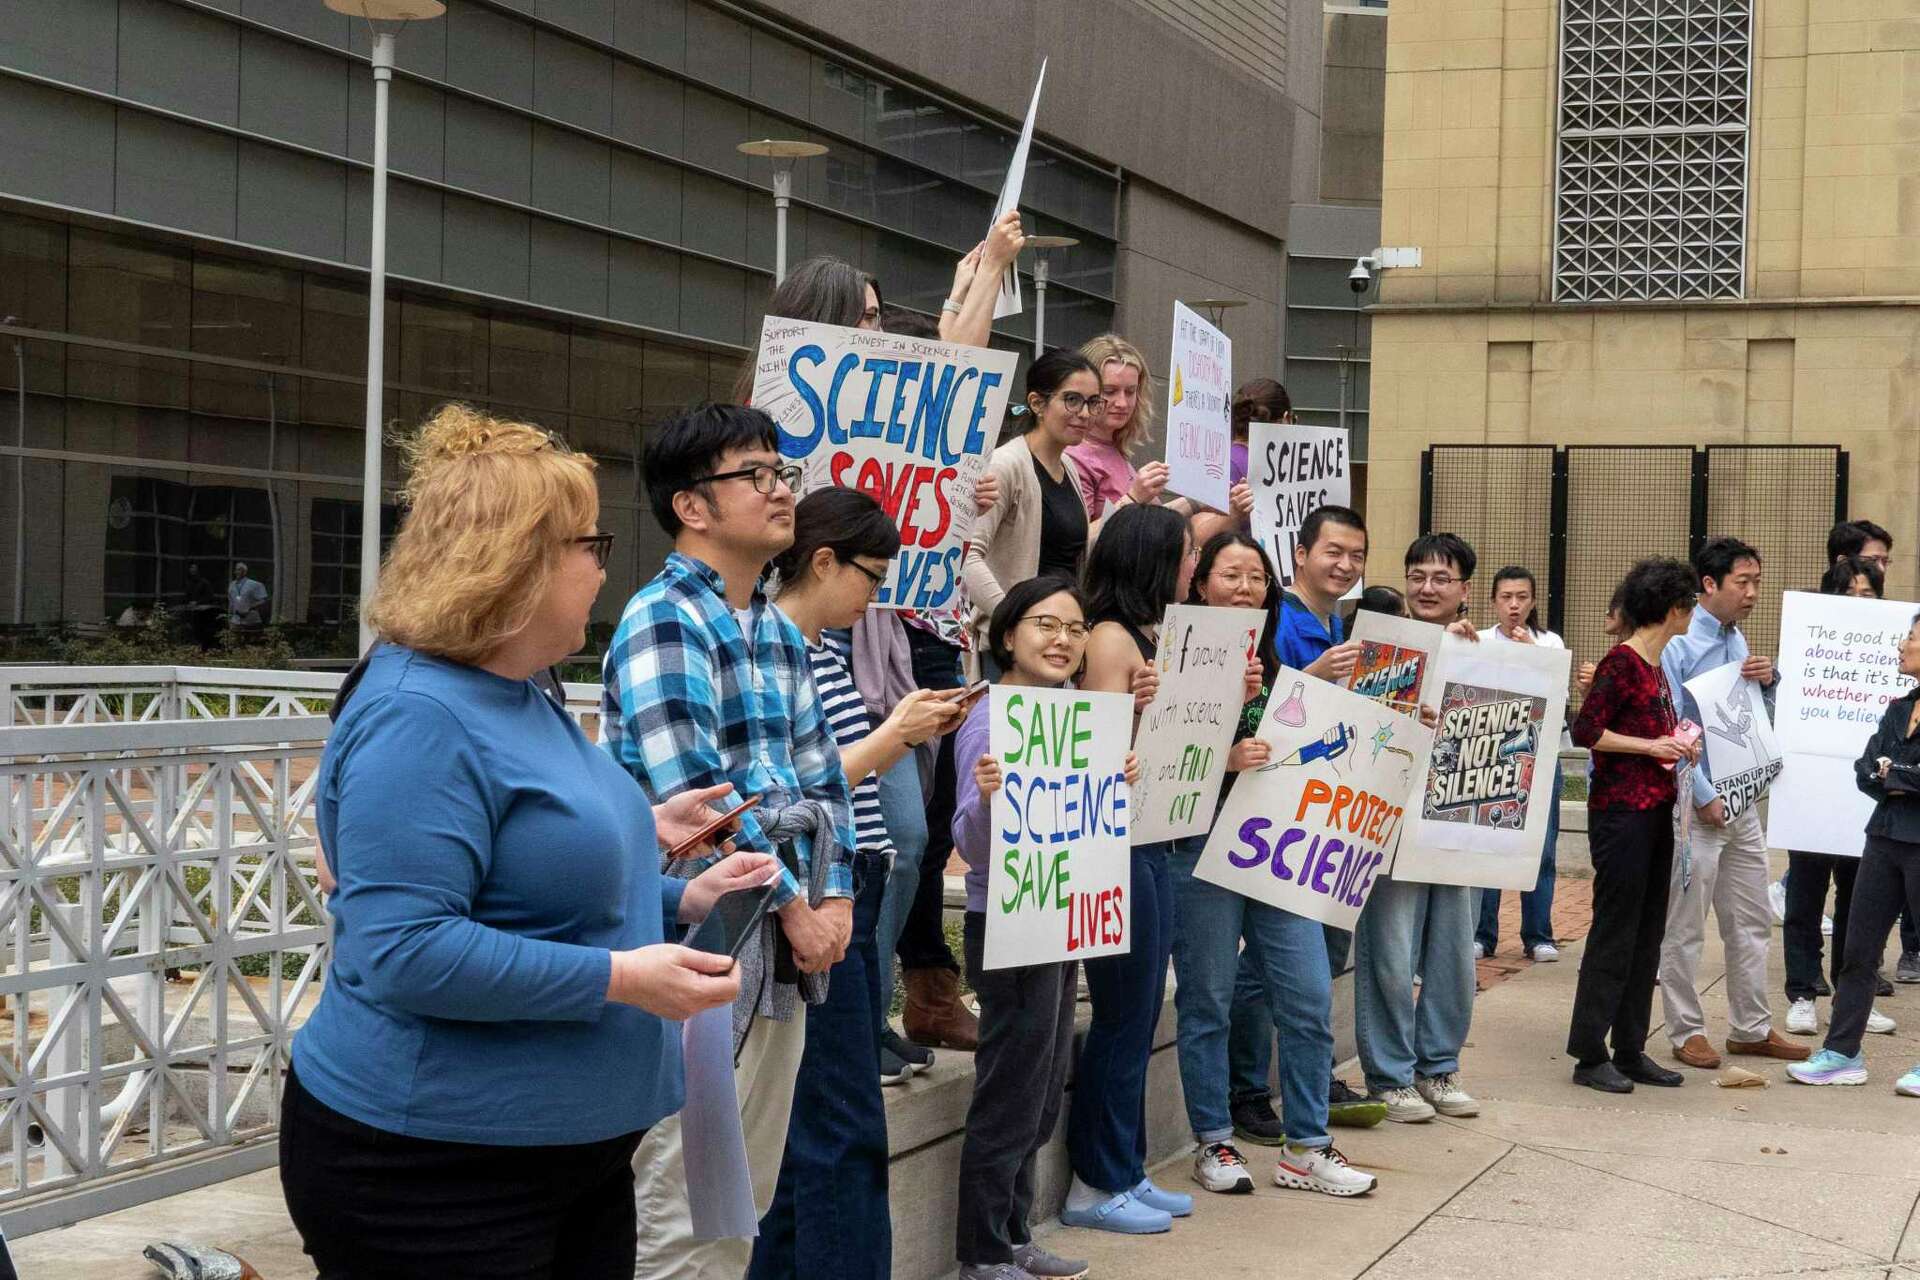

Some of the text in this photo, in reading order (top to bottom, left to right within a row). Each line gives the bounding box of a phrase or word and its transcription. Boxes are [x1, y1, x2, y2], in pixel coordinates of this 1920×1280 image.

[764, 327, 808, 341] SUPPORT
[767, 345, 785, 356] THE
[849, 333, 888, 348] INVEST
[893, 341, 905, 350] IN
[776, 344, 1003, 466] SCIENCE
[1263, 437, 1343, 487] SCIENCE
[1805, 643, 1900, 666] about scien
[1808, 625, 1837, 640] The
[1842, 631, 1883, 646] good
[1192, 644, 1229, 668] around
[1803, 662, 1920, 688] is that it's tru
[1353, 656, 1420, 696] SCIENCE
[1802, 684, 1872, 703] whether
[1004, 694, 1092, 769] SAVE
[1800, 704, 1885, 724] you believ
[1158, 744, 1214, 782] and FIND
[1457, 733, 1506, 771] NOT
[1431, 763, 1522, 807] SILENCE!
[1715, 761, 1781, 794] STAND UP FOR
[1002, 772, 1126, 845] SCIENCE
[1169, 792, 1201, 826] OUT
[1295, 778, 1403, 849] PROTECT
[1001, 849, 1071, 914] SAVE
[1227, 817, 1383, 908] SCIENCE
[1067, 885, 1123, 952] LIVES
